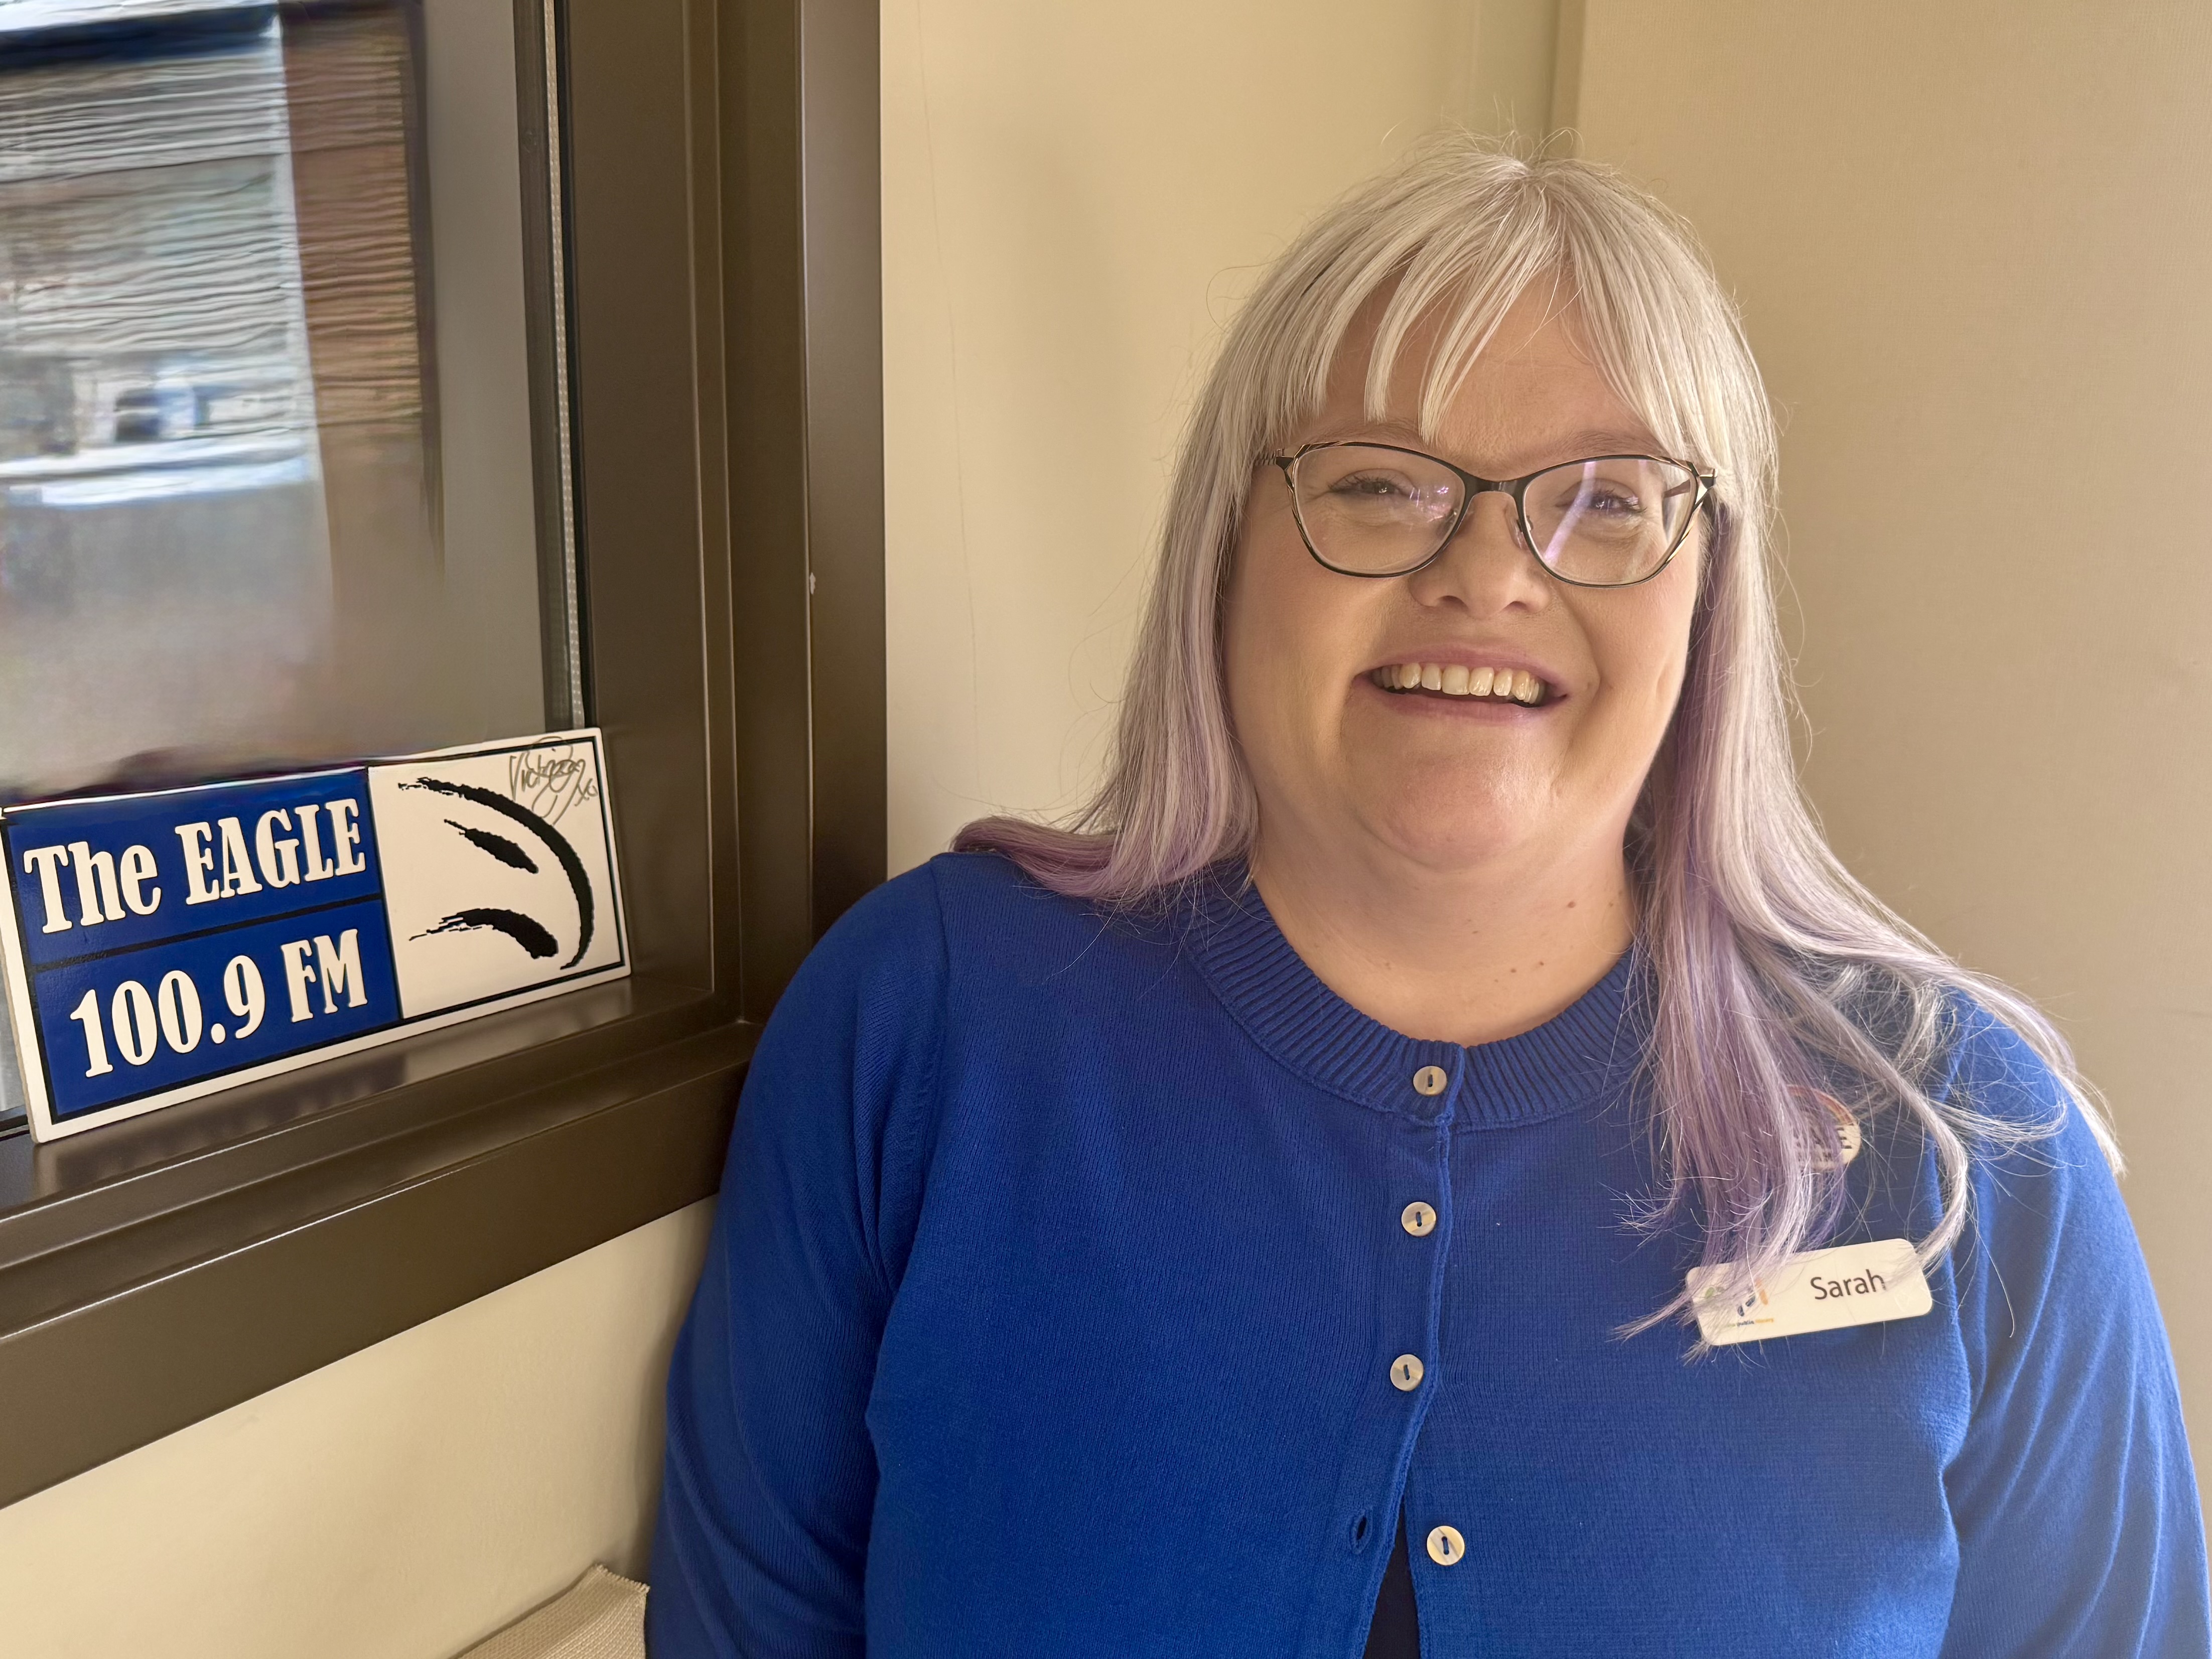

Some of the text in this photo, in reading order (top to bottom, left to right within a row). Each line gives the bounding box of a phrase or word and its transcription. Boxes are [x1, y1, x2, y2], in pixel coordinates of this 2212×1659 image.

[24, 799, 365, 933] The EAGLE
[70, 929, 367, 1077] 100.9 FM
[1810, 1269, 1886, 1300] Sarah
